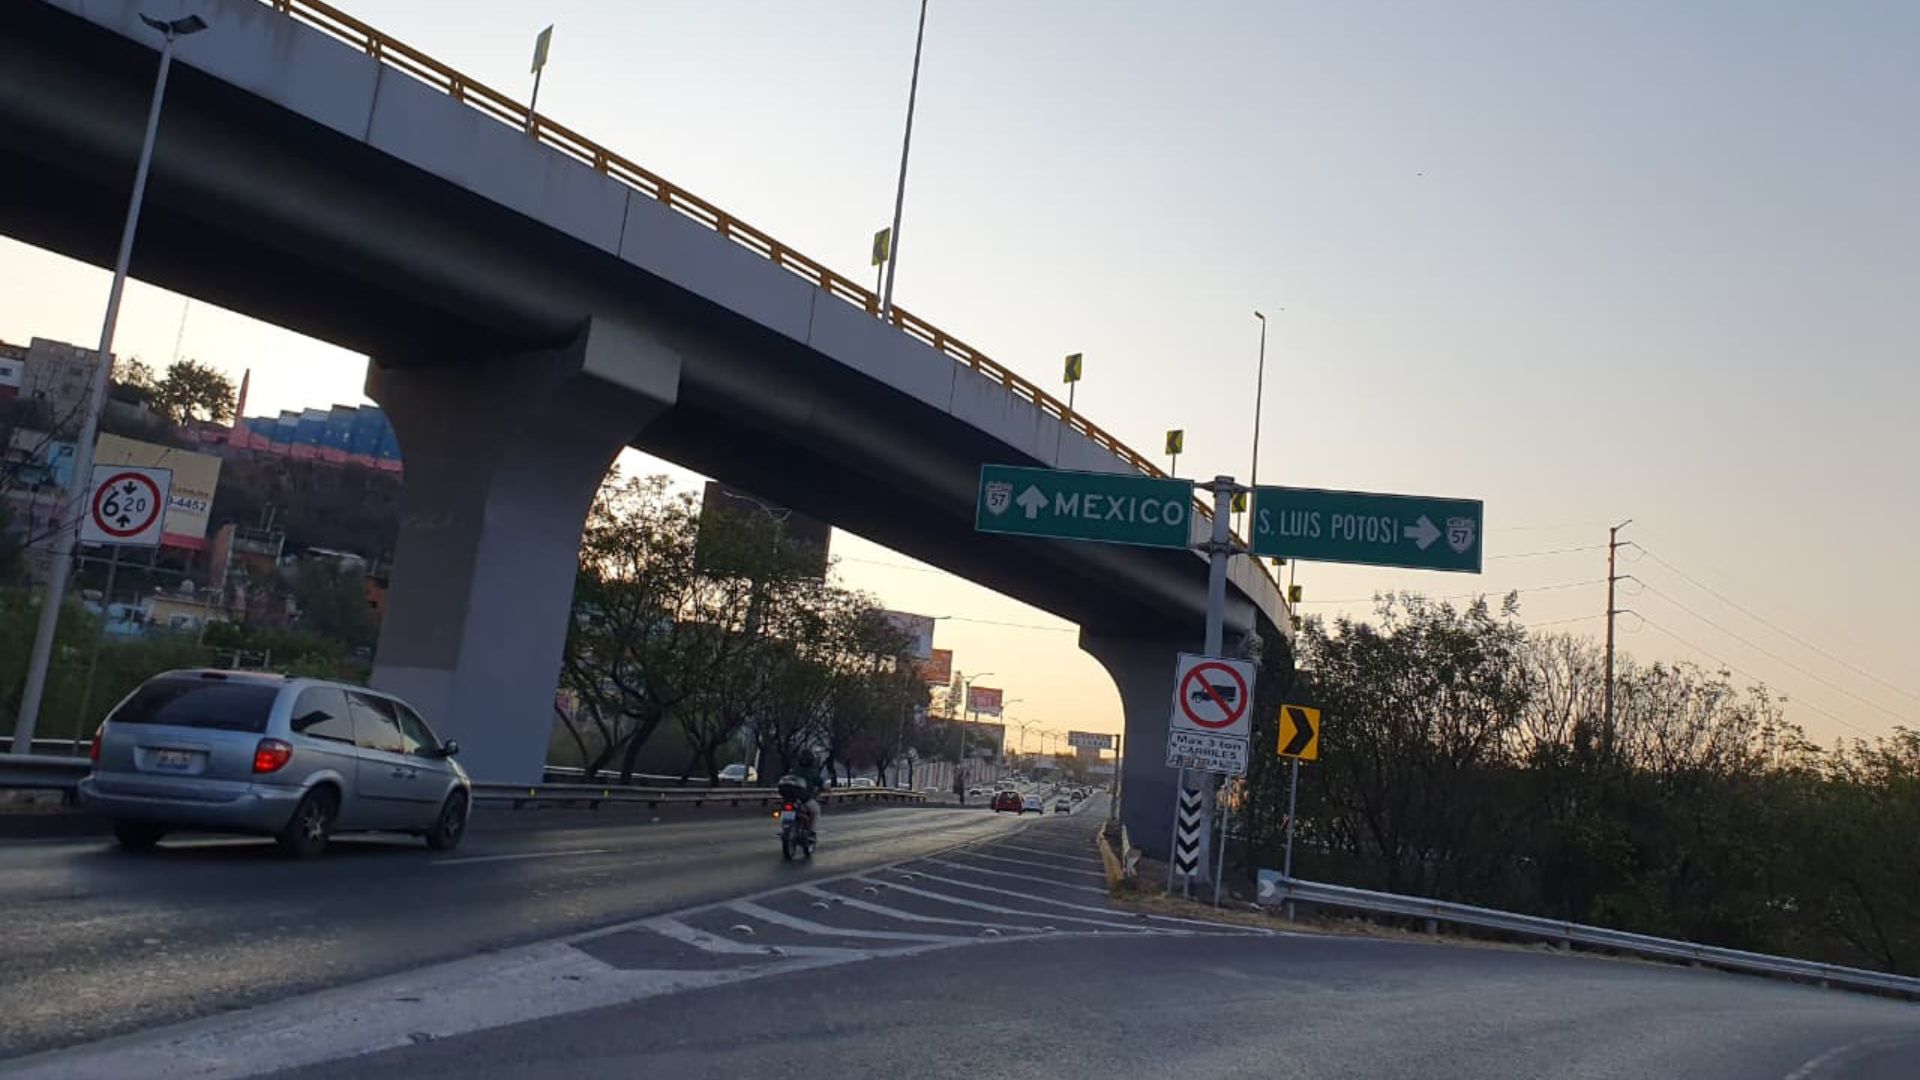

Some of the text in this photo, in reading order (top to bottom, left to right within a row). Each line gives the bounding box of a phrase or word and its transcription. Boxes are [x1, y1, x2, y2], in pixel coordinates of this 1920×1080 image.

[990, 491, 1184, 525] 57 MEXICO
[1258, 508, 1468, 544] S. LUIS POTOSI 57
